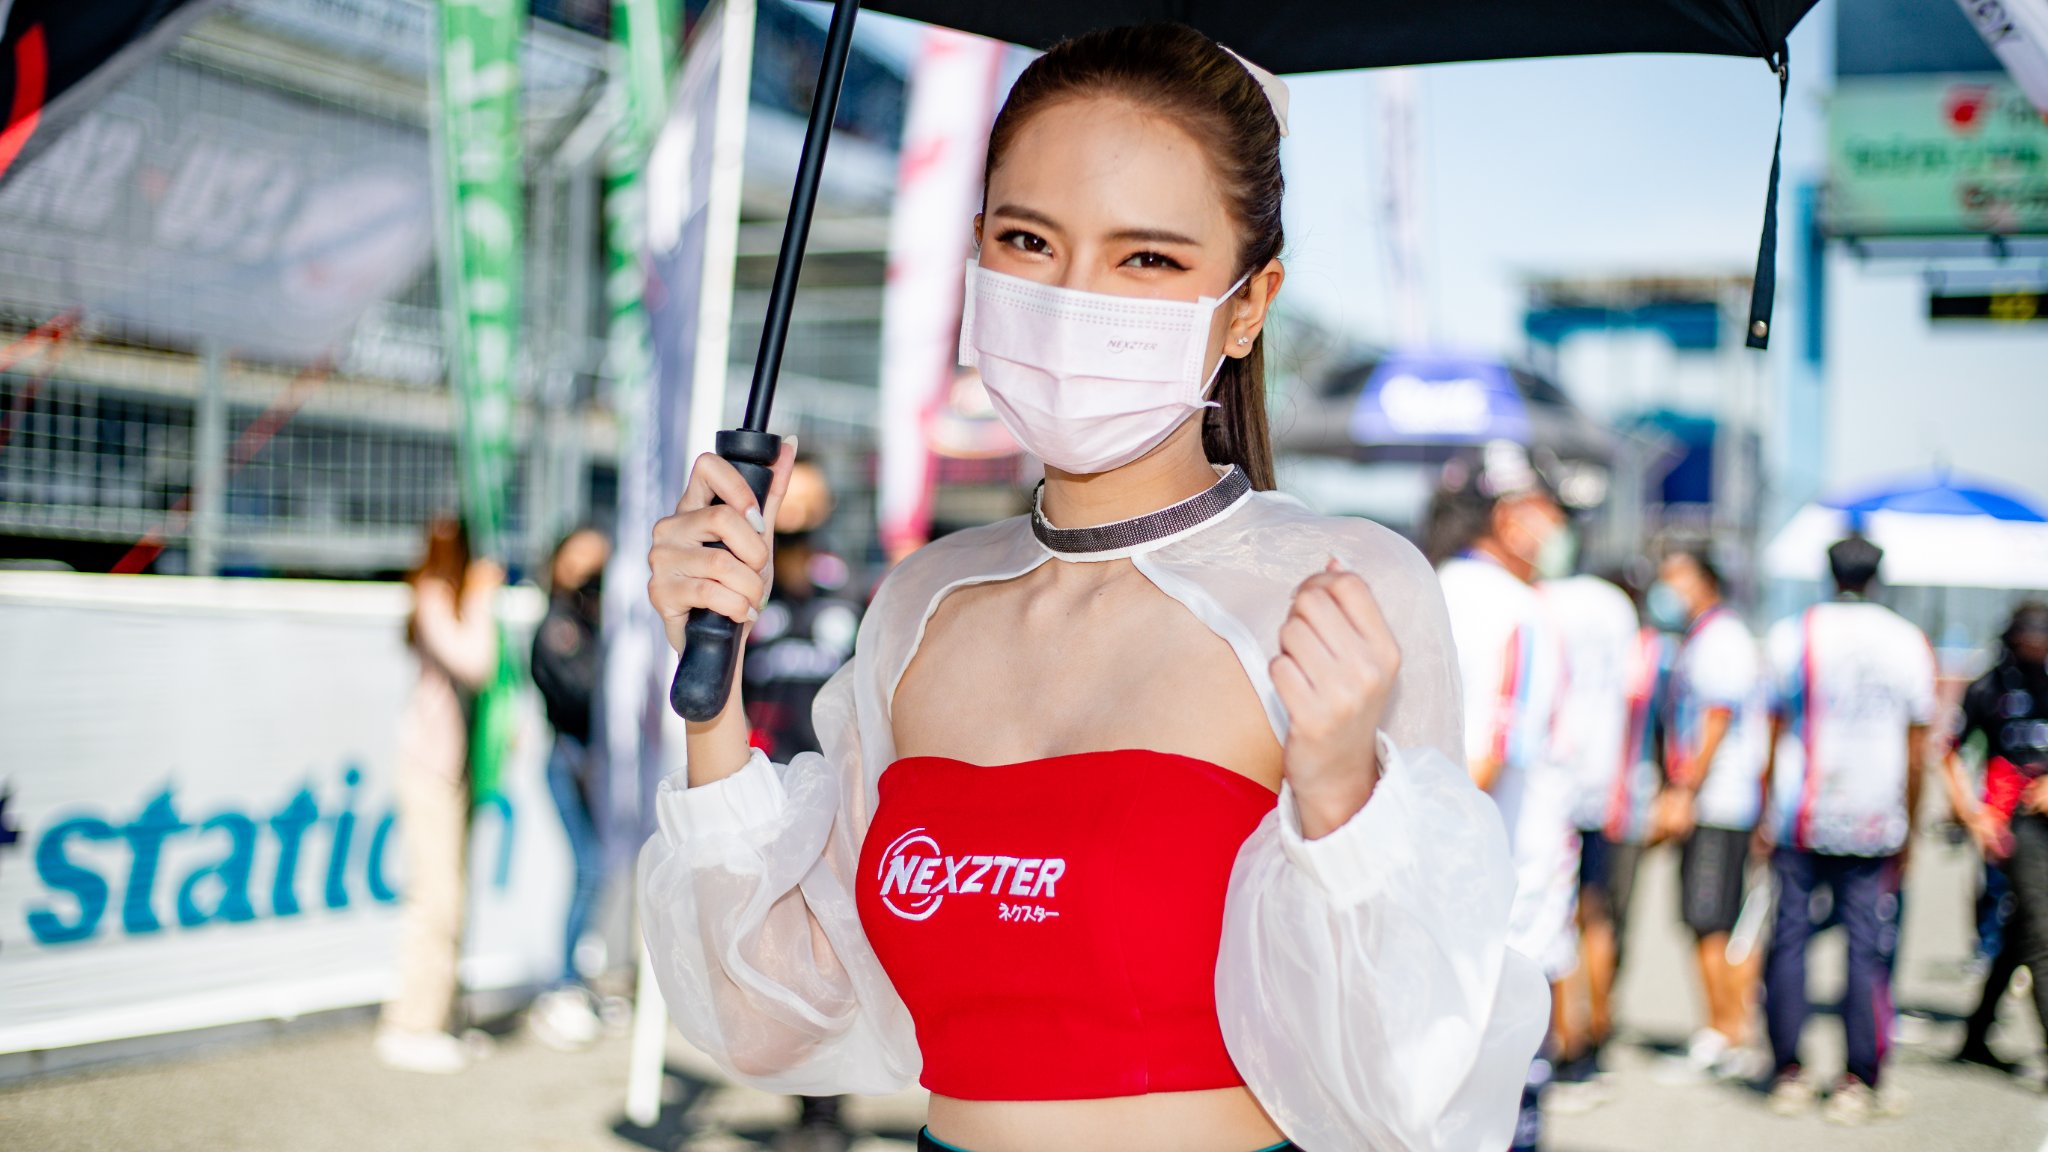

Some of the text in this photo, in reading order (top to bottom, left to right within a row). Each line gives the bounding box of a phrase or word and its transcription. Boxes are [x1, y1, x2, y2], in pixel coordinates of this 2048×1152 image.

[1106, 339, 1159, 351] NEXZTER
[879, 855, 1066, 897] NEXZTER
[998, 902, 1060, 923] ネクスター
